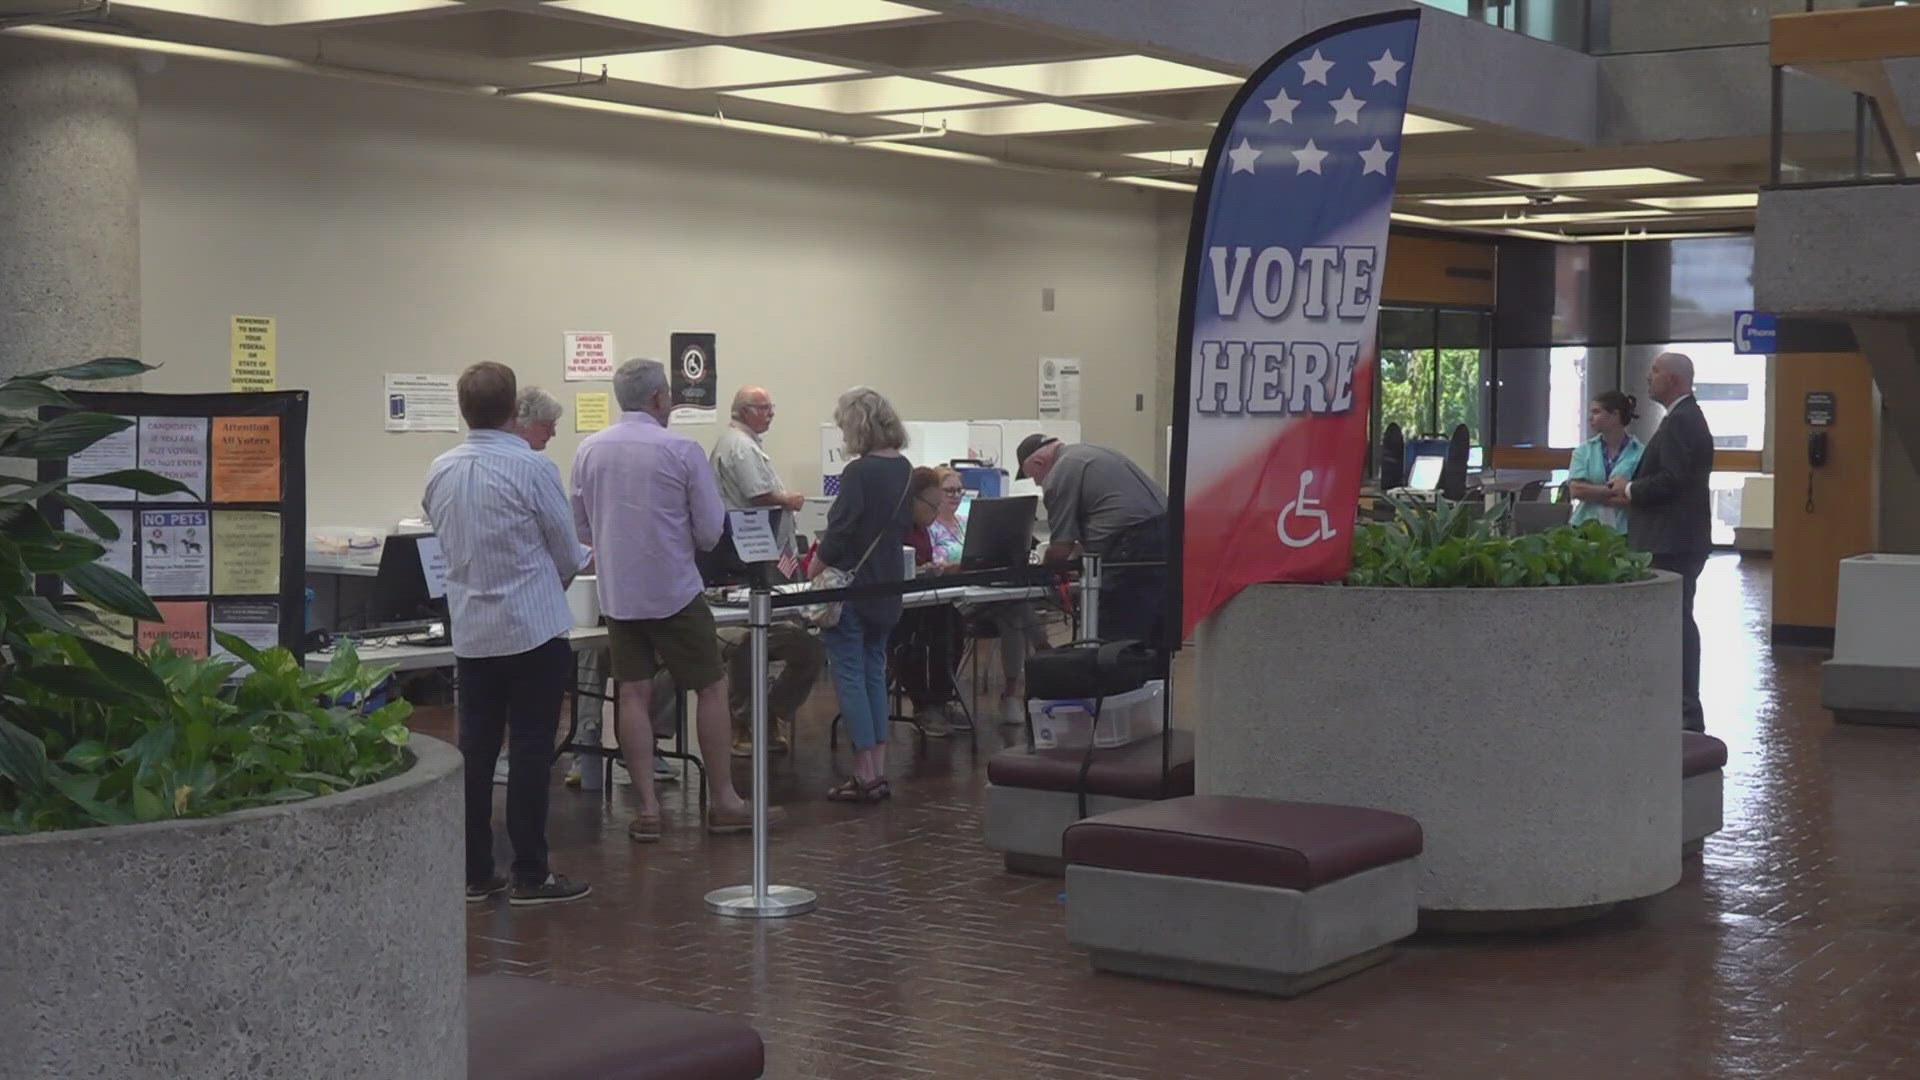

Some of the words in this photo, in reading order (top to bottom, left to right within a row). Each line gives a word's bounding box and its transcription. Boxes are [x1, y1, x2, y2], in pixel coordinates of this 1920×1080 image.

[1208, 245, 1376, 319] VOTE
[1197, 340, 1361, 413] HERE
[223, 423, 270, 431] Attention
[236, 437, 271, 445] Voters
[149, 447, 164, 455] NOT
[145, 515, 164, 525] NO
[171, 514, 203, 525] PETS
[143, 631, 203, 640] MUICIPAL
